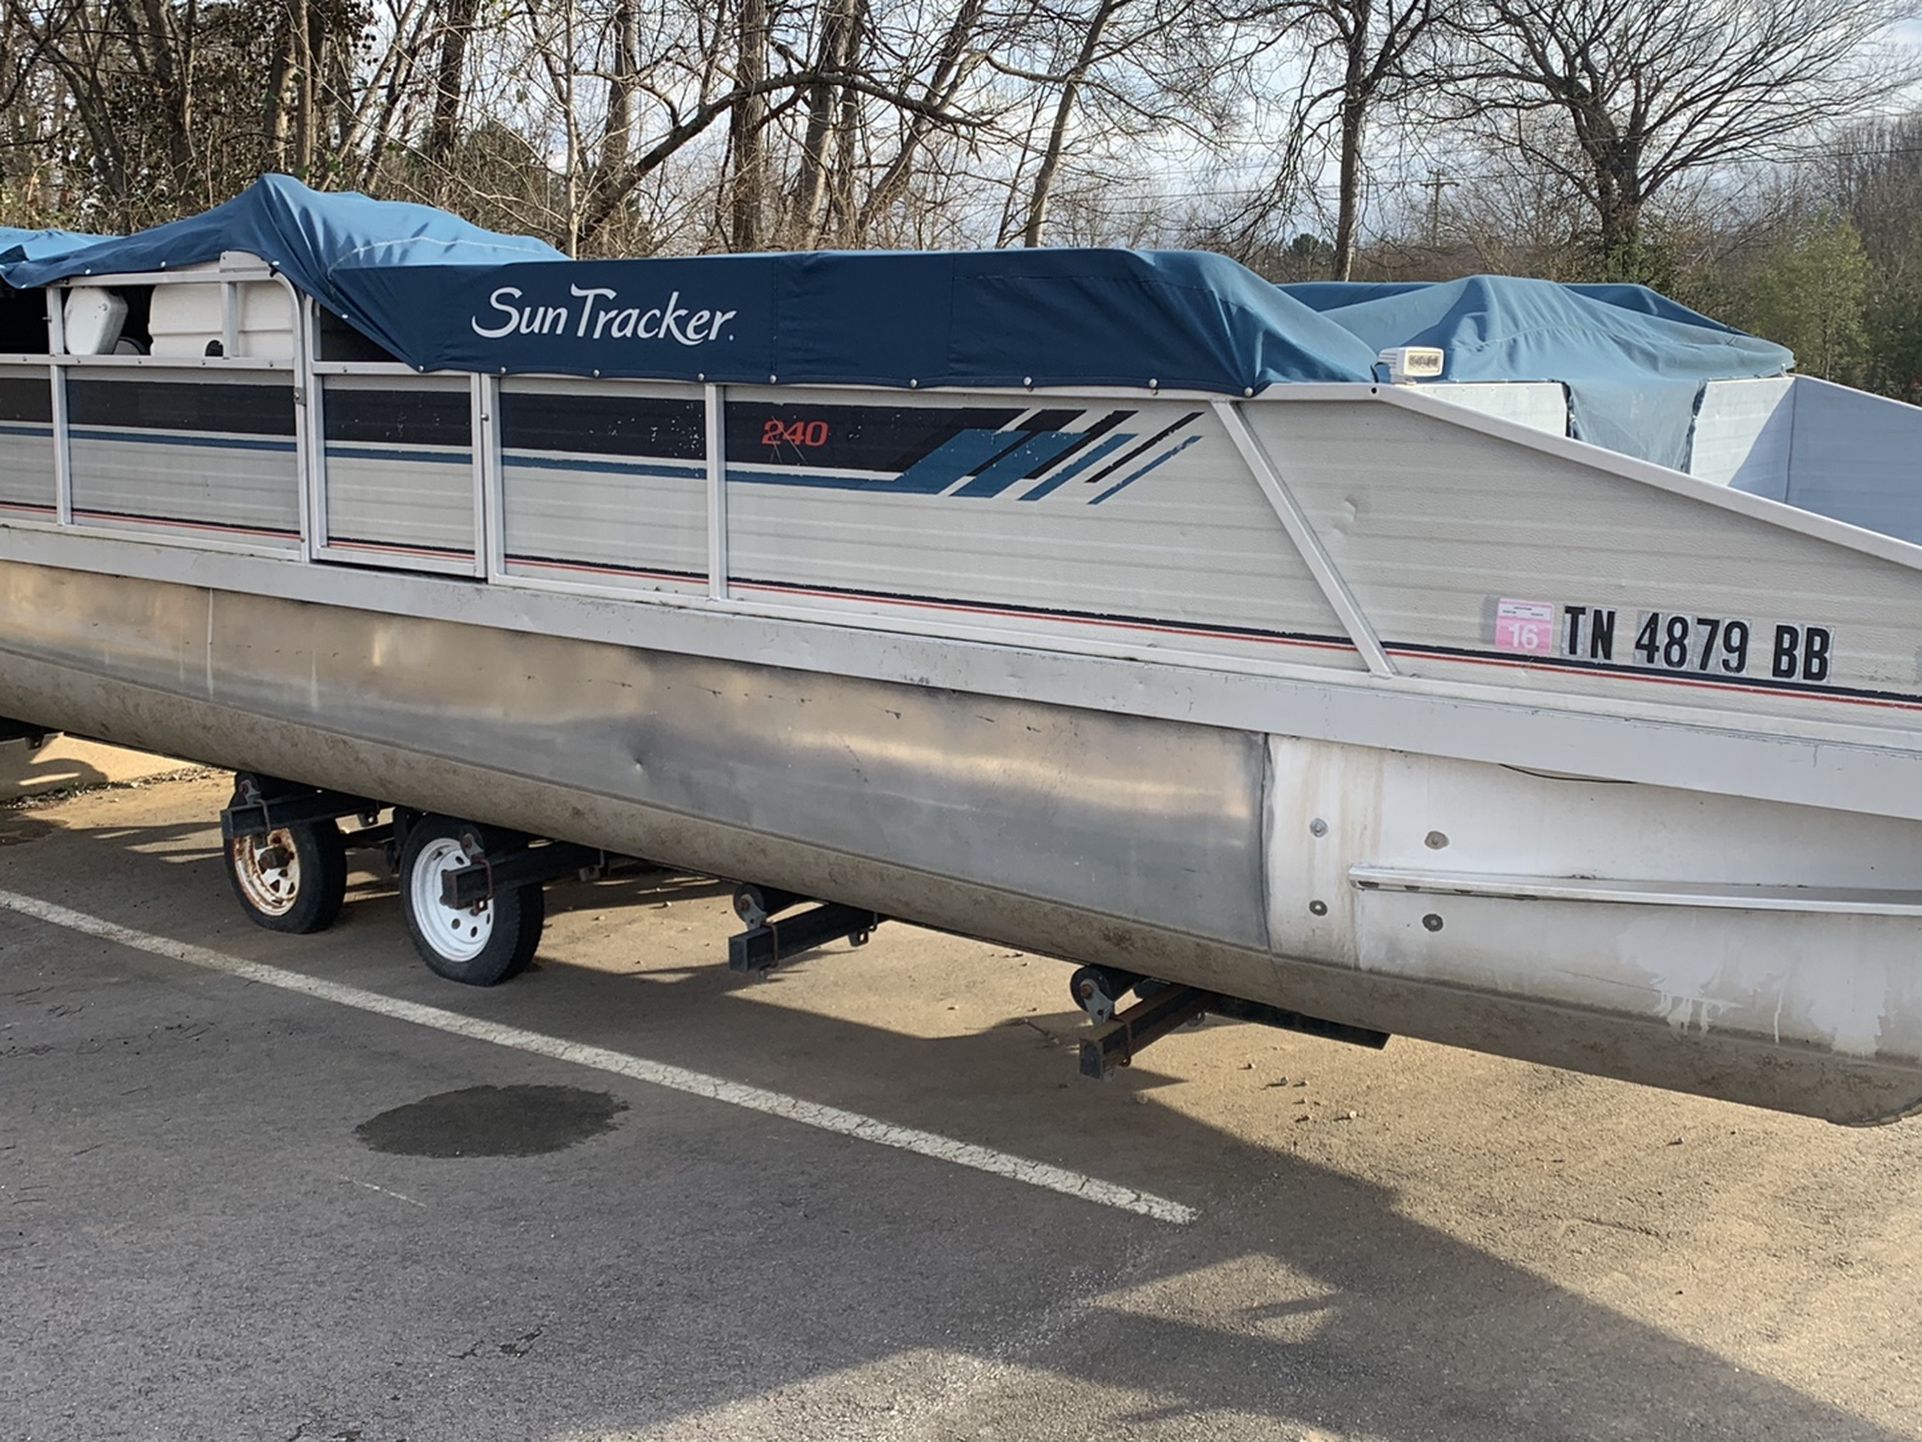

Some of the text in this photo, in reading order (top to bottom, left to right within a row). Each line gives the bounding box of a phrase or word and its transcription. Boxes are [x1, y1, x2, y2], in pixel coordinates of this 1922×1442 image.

[471, 287, 568, 338] Sun
[761, 420, 829, 446] 240
[1509, 623, 1539, 650] 16
[1564, 605, 1831, 682] TN 4879 BB
